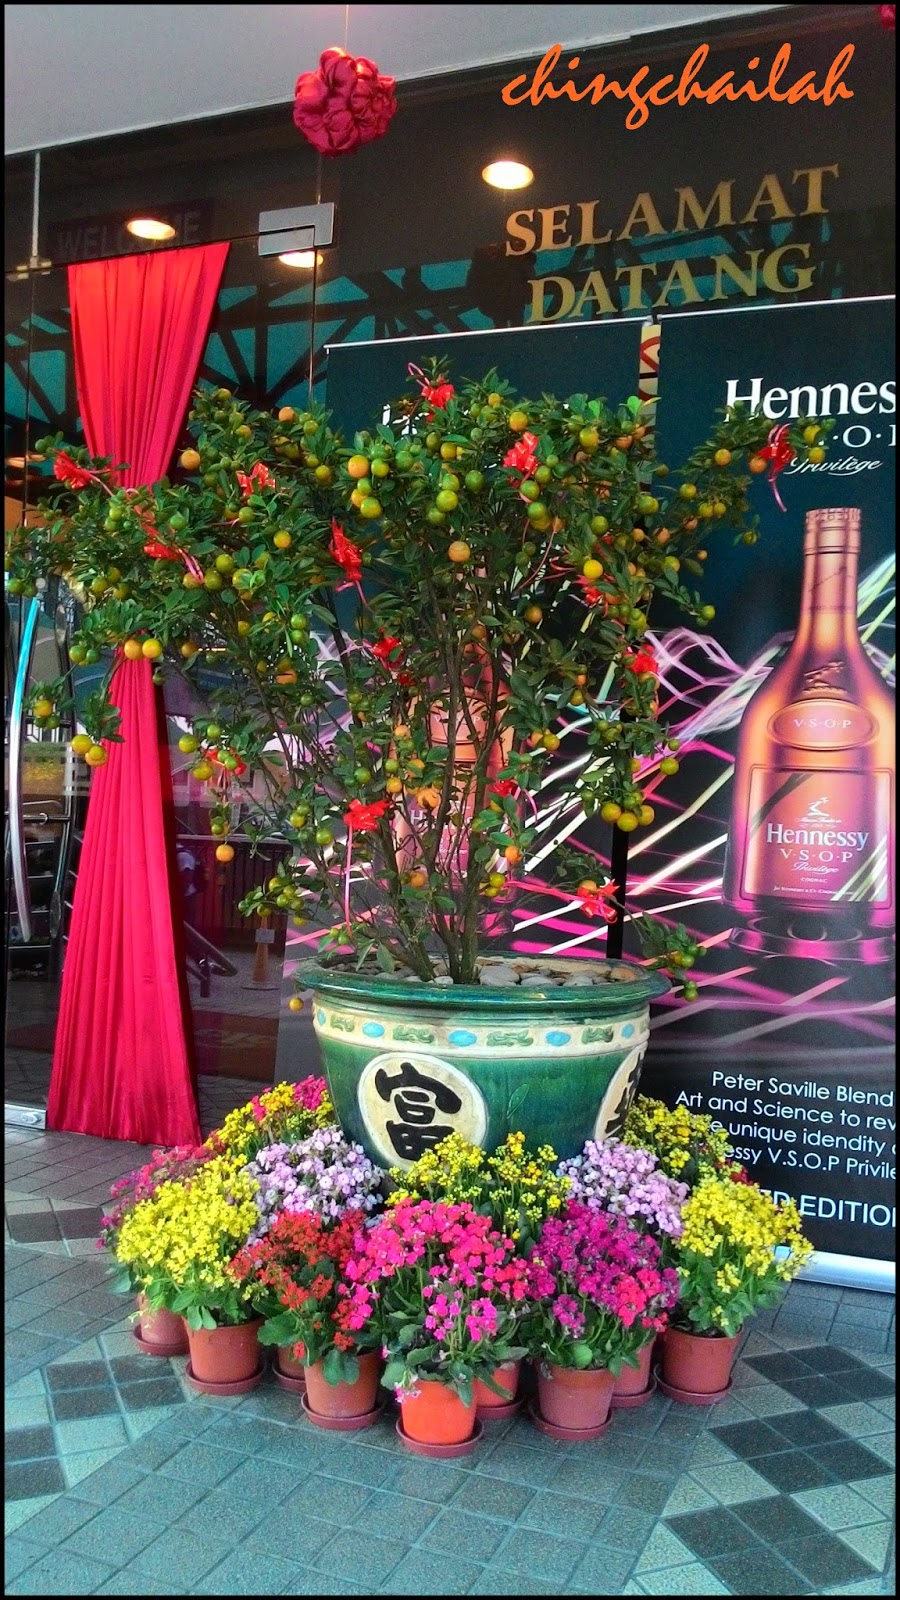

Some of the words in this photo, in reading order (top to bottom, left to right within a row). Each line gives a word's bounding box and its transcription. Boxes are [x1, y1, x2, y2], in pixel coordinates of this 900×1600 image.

[505, 163, 840, 257] SELAMAT
[527, 243, 817, 324] DATANG
[766, 822, 870, 852] Hennessy
[712, 1071, 764, 1092] Peter
[768, 1077, 830, 1100] Saville
[836, 1086, 894, 1107] Blend
[375, 1062, 462, 1161] 富
[675, 1090, 703, 1107] Art
[708, 1096, 747, 1113] and
[753, 1099, 834, 1124] Science
[840, 1109, 860, 1127] to
[729, 1121, 797, 1143] unique
[803, 1128, 886, 1157] idendity
[768, 1147, 839, 1171] V.S.O.P
